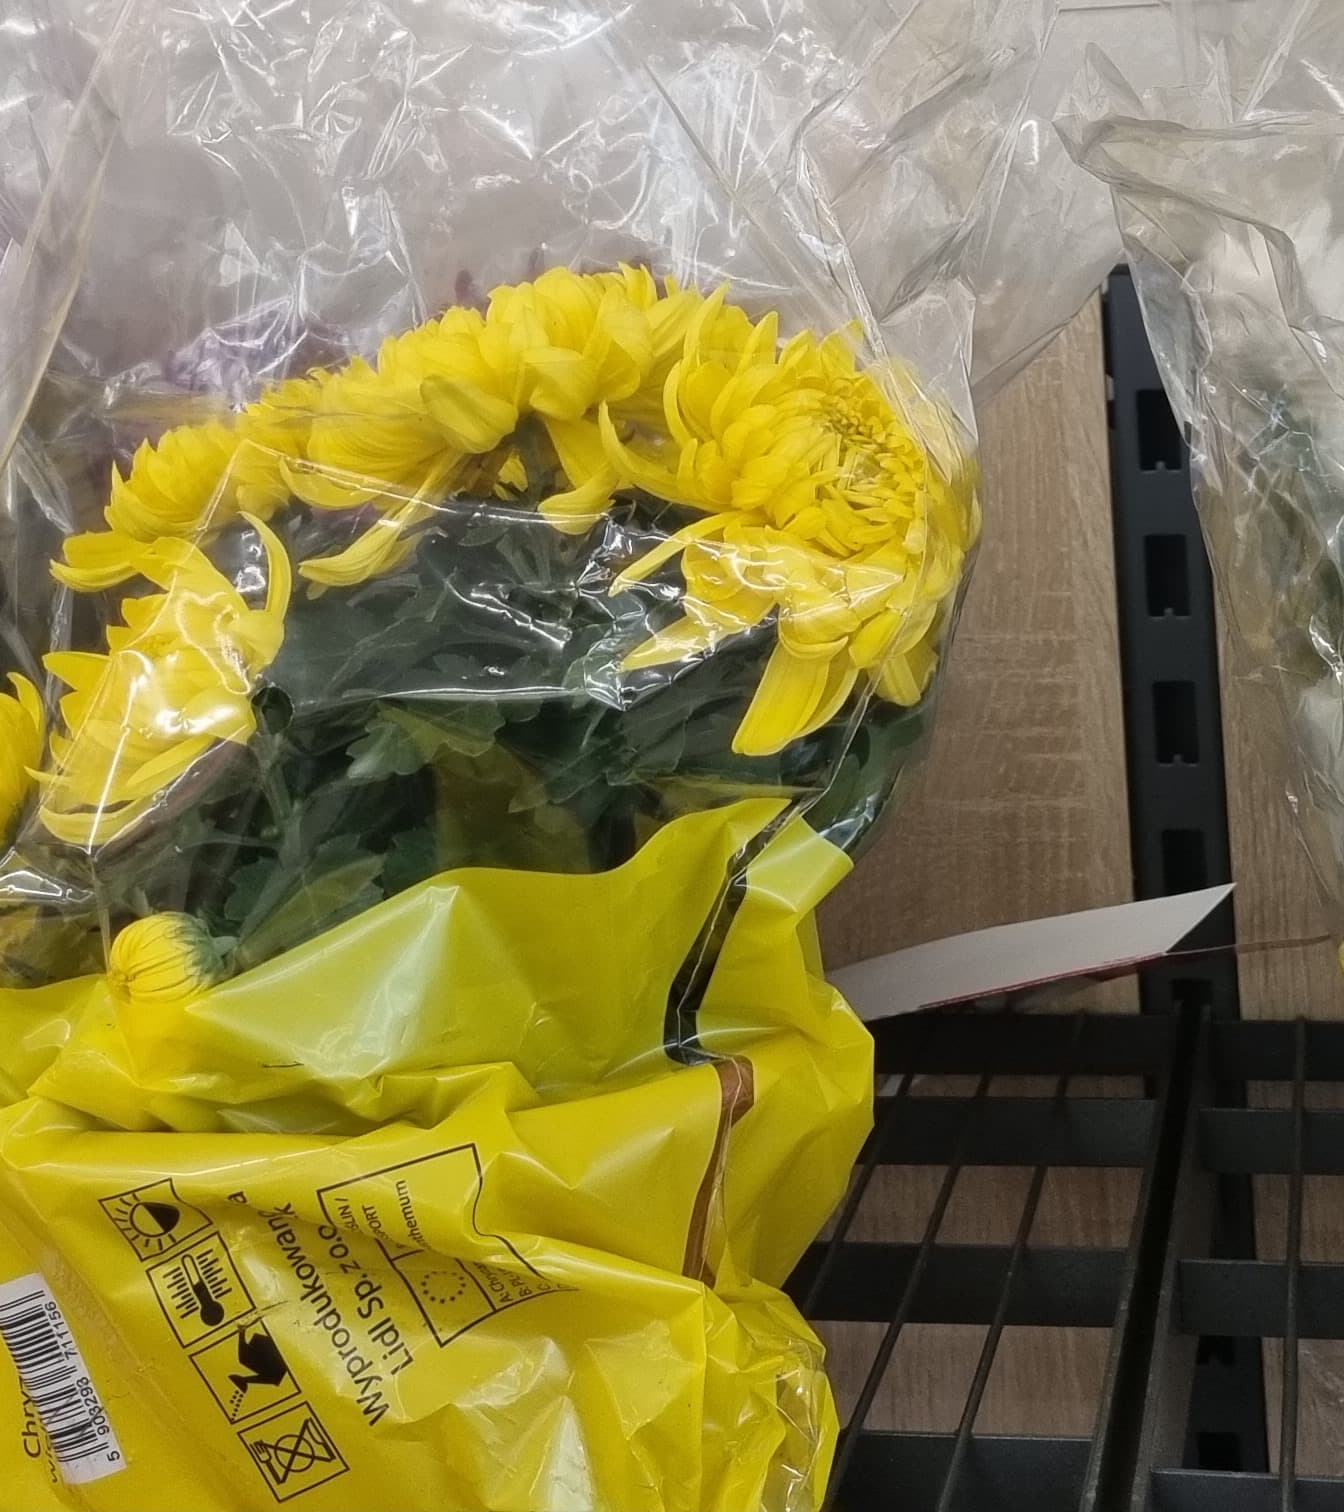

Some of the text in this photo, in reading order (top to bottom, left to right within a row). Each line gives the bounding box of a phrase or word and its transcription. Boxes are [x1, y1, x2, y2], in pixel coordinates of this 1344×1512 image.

[339, 1256, 361, 1274] z
[367, 1317, 414, 1376] Lidl
[44, 1301, 120, 1462] 5 903293 711156
